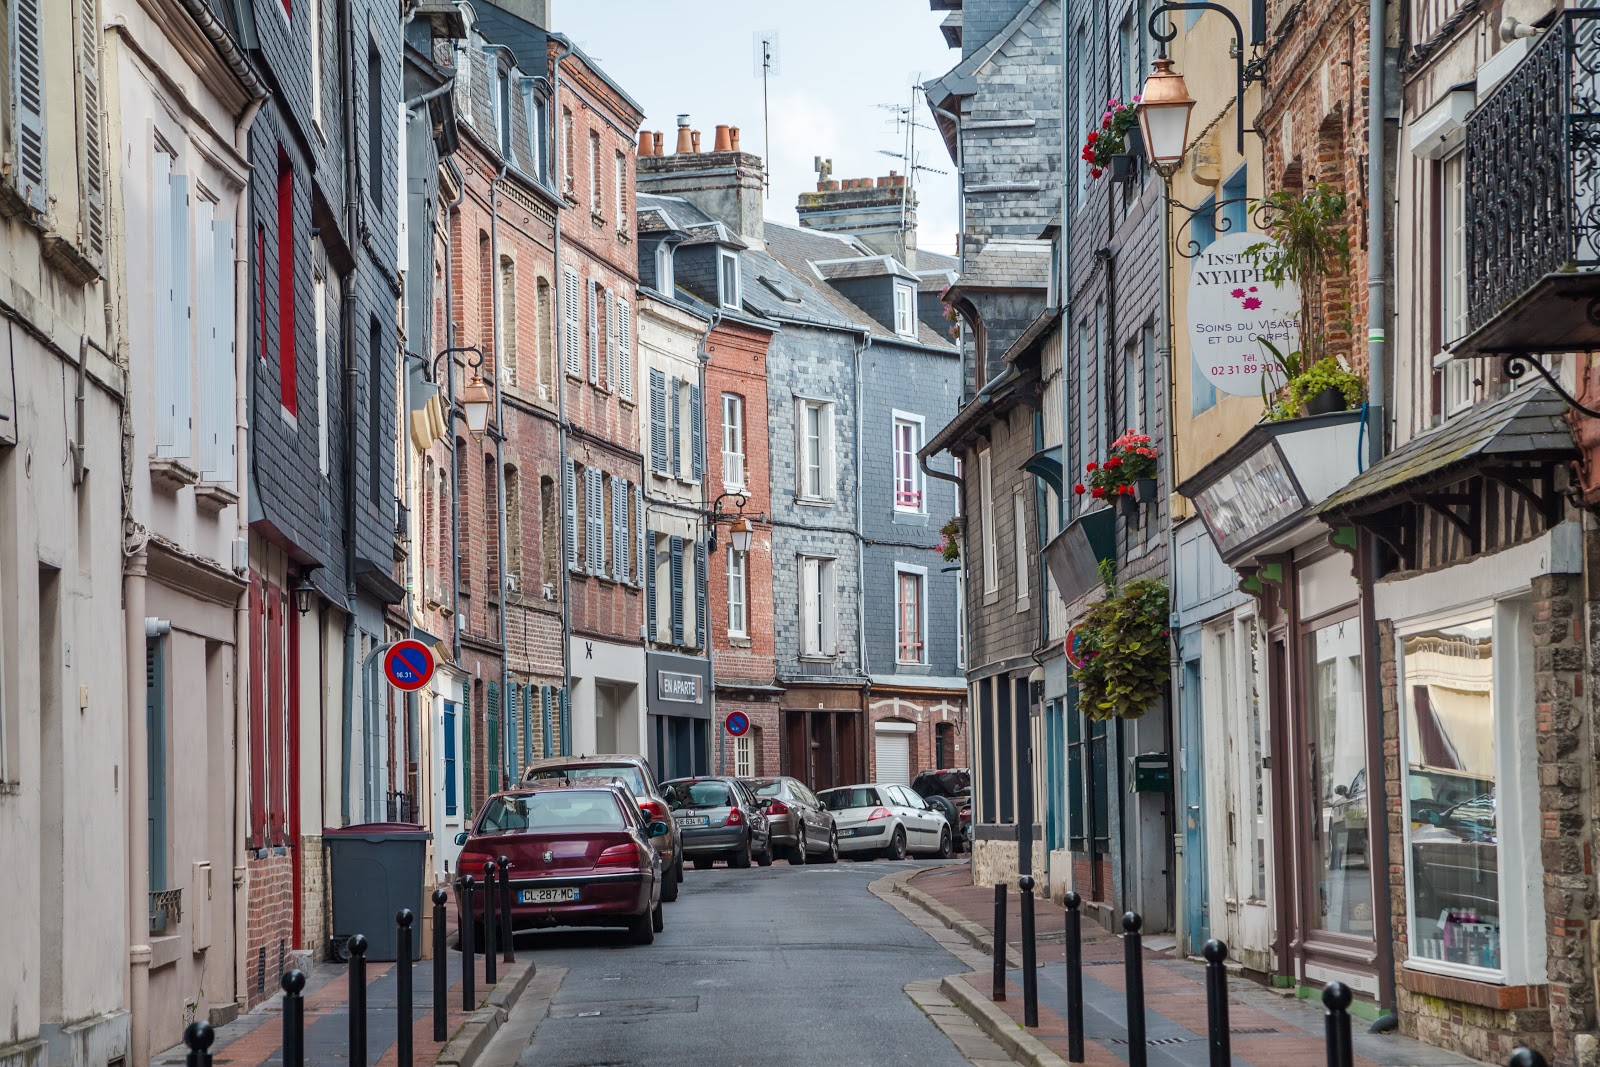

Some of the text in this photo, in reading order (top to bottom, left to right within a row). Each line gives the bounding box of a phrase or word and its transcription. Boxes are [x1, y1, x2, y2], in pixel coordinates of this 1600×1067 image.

[1208, 251, 1284, 266] INSTI
[1196, 266, 1296, 286] NYMPHA
[1242, 353, 1258, 362] Tél.
[1211, 366, 1225, 376] 02
[1228, 365, 1240, 375] 31
[1243, 364, 1258, 374] 89
[664, 678, 673, 693] EN
